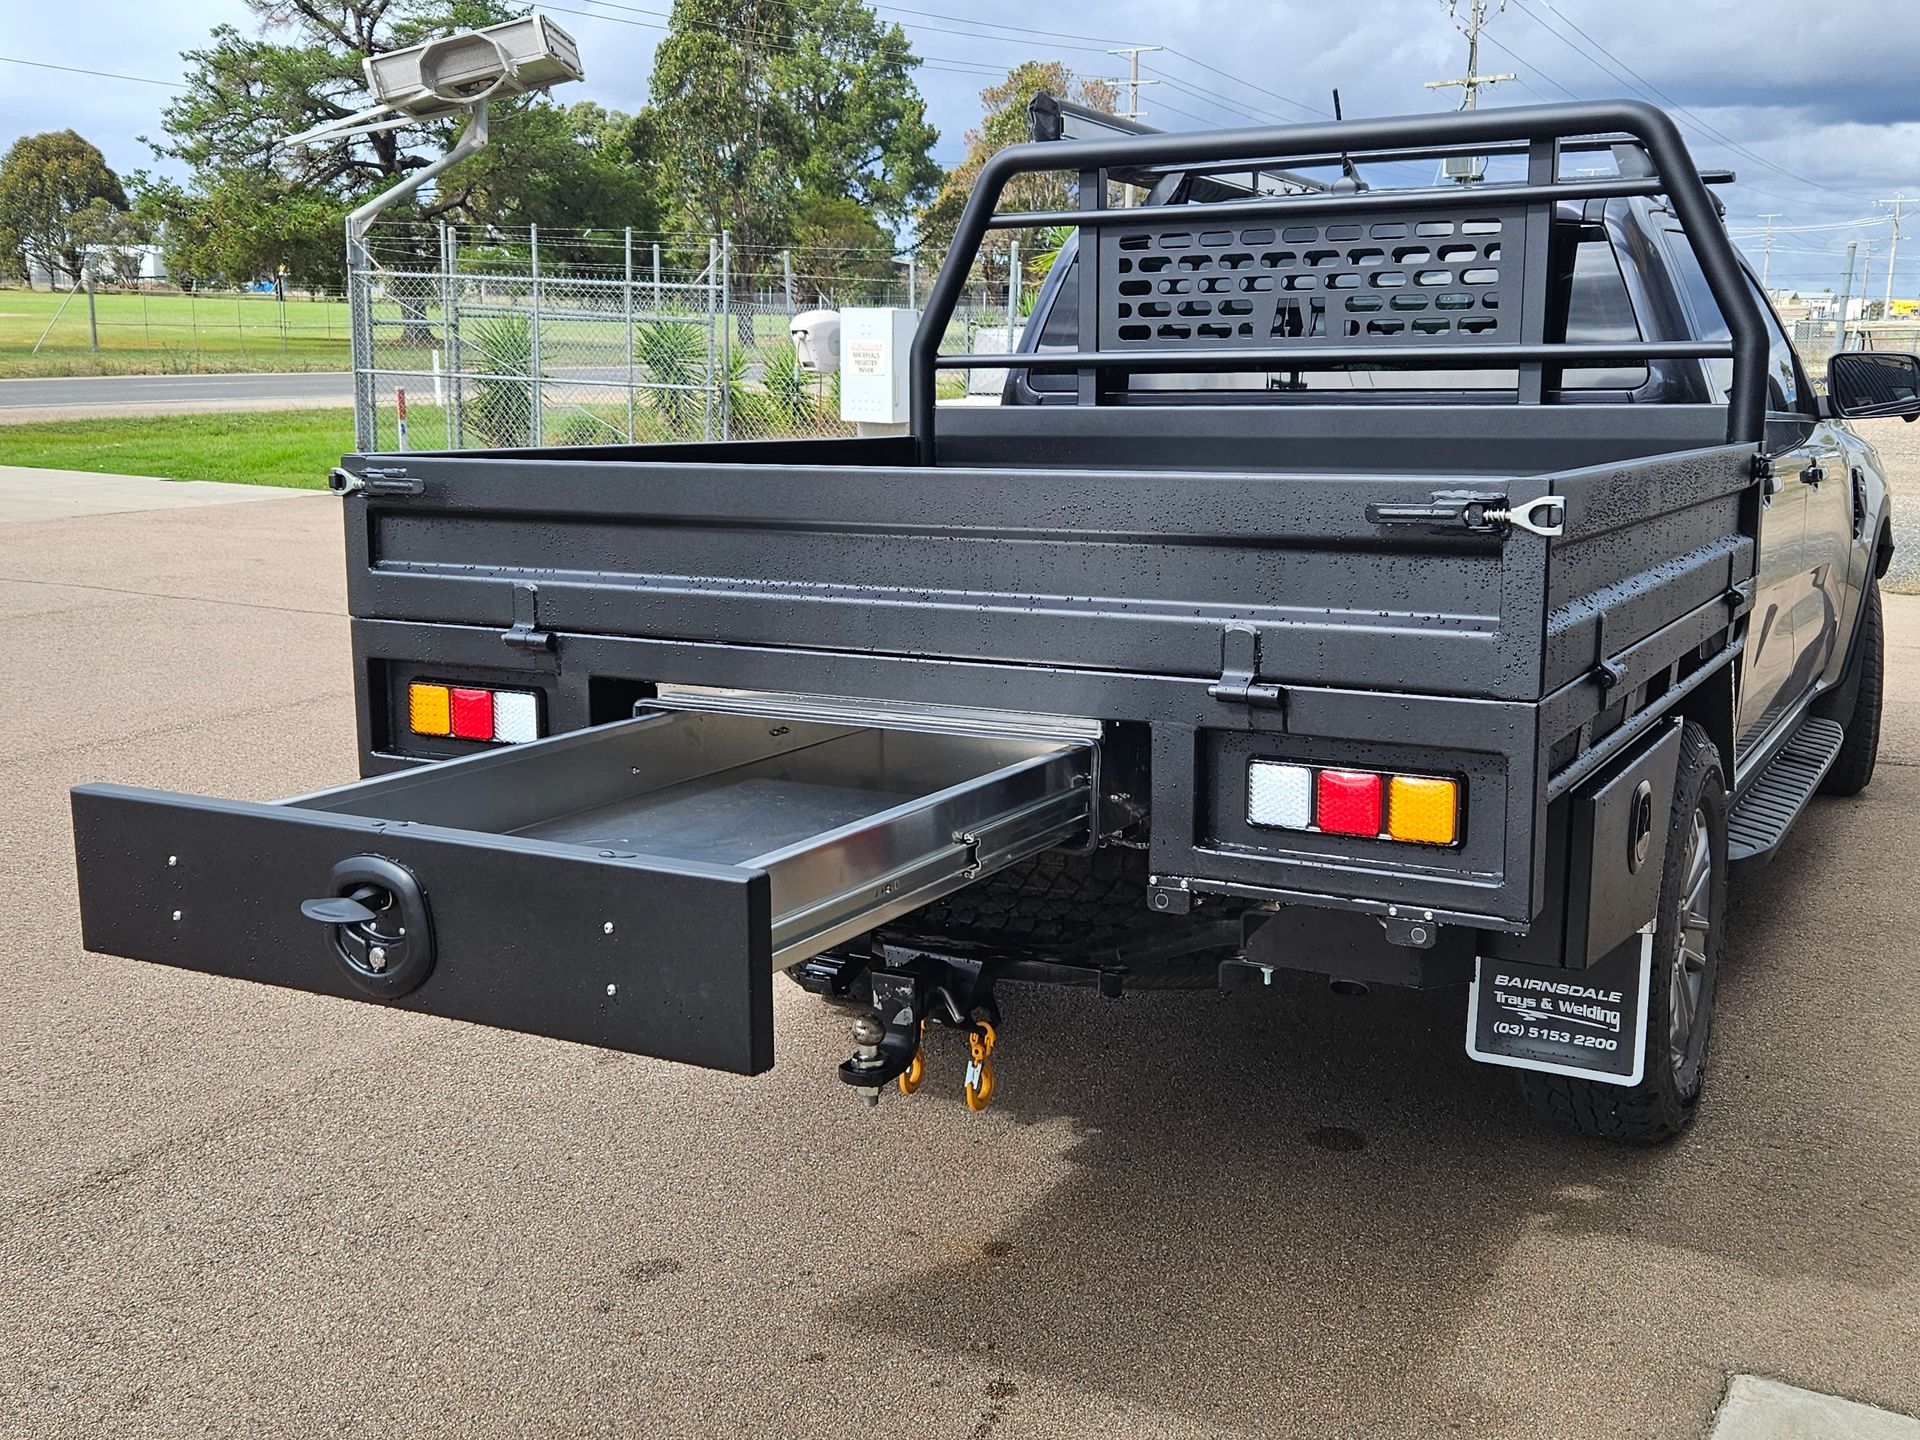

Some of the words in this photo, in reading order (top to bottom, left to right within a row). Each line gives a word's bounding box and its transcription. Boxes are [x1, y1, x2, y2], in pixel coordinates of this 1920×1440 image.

[1494, 974, 1623, 1003] BAIRNSDALE
[1494, 990, 1537, 1009] Trays
[1540, 997, 1553, 1010] &
[1558, 1000, 1620, 1032] Welding
[1493, 1021, 1525, 1037] (03)
[1528, 1027, 1571, 1043] 5153
[1573, 1034, 1618, 1051] 2200
